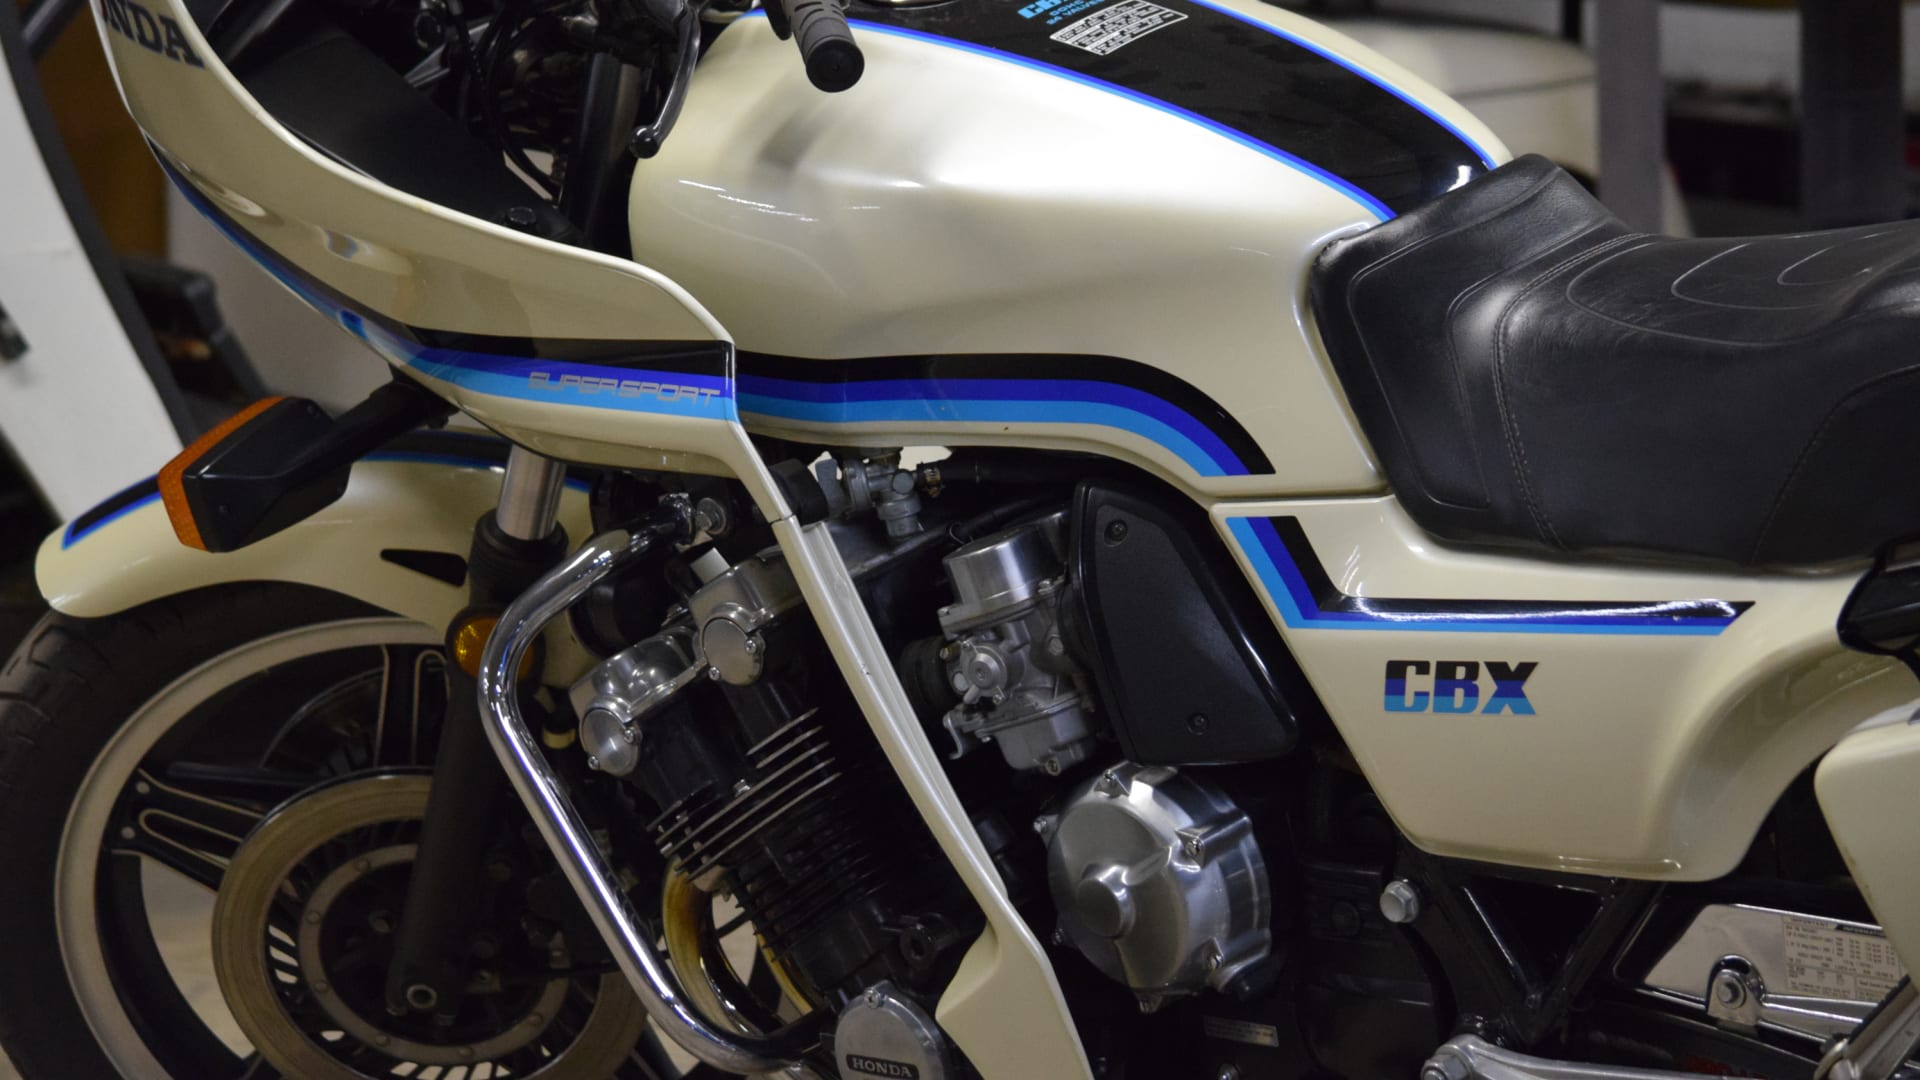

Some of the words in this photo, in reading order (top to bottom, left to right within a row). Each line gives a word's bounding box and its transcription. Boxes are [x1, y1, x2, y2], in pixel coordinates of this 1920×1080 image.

[1017, 0, 1068, 19] CB
[101, 0, 206, 69] NDA
[1384, 660, 1539, 715] CBX
[852, 1056, 913, 1078] HONDA
